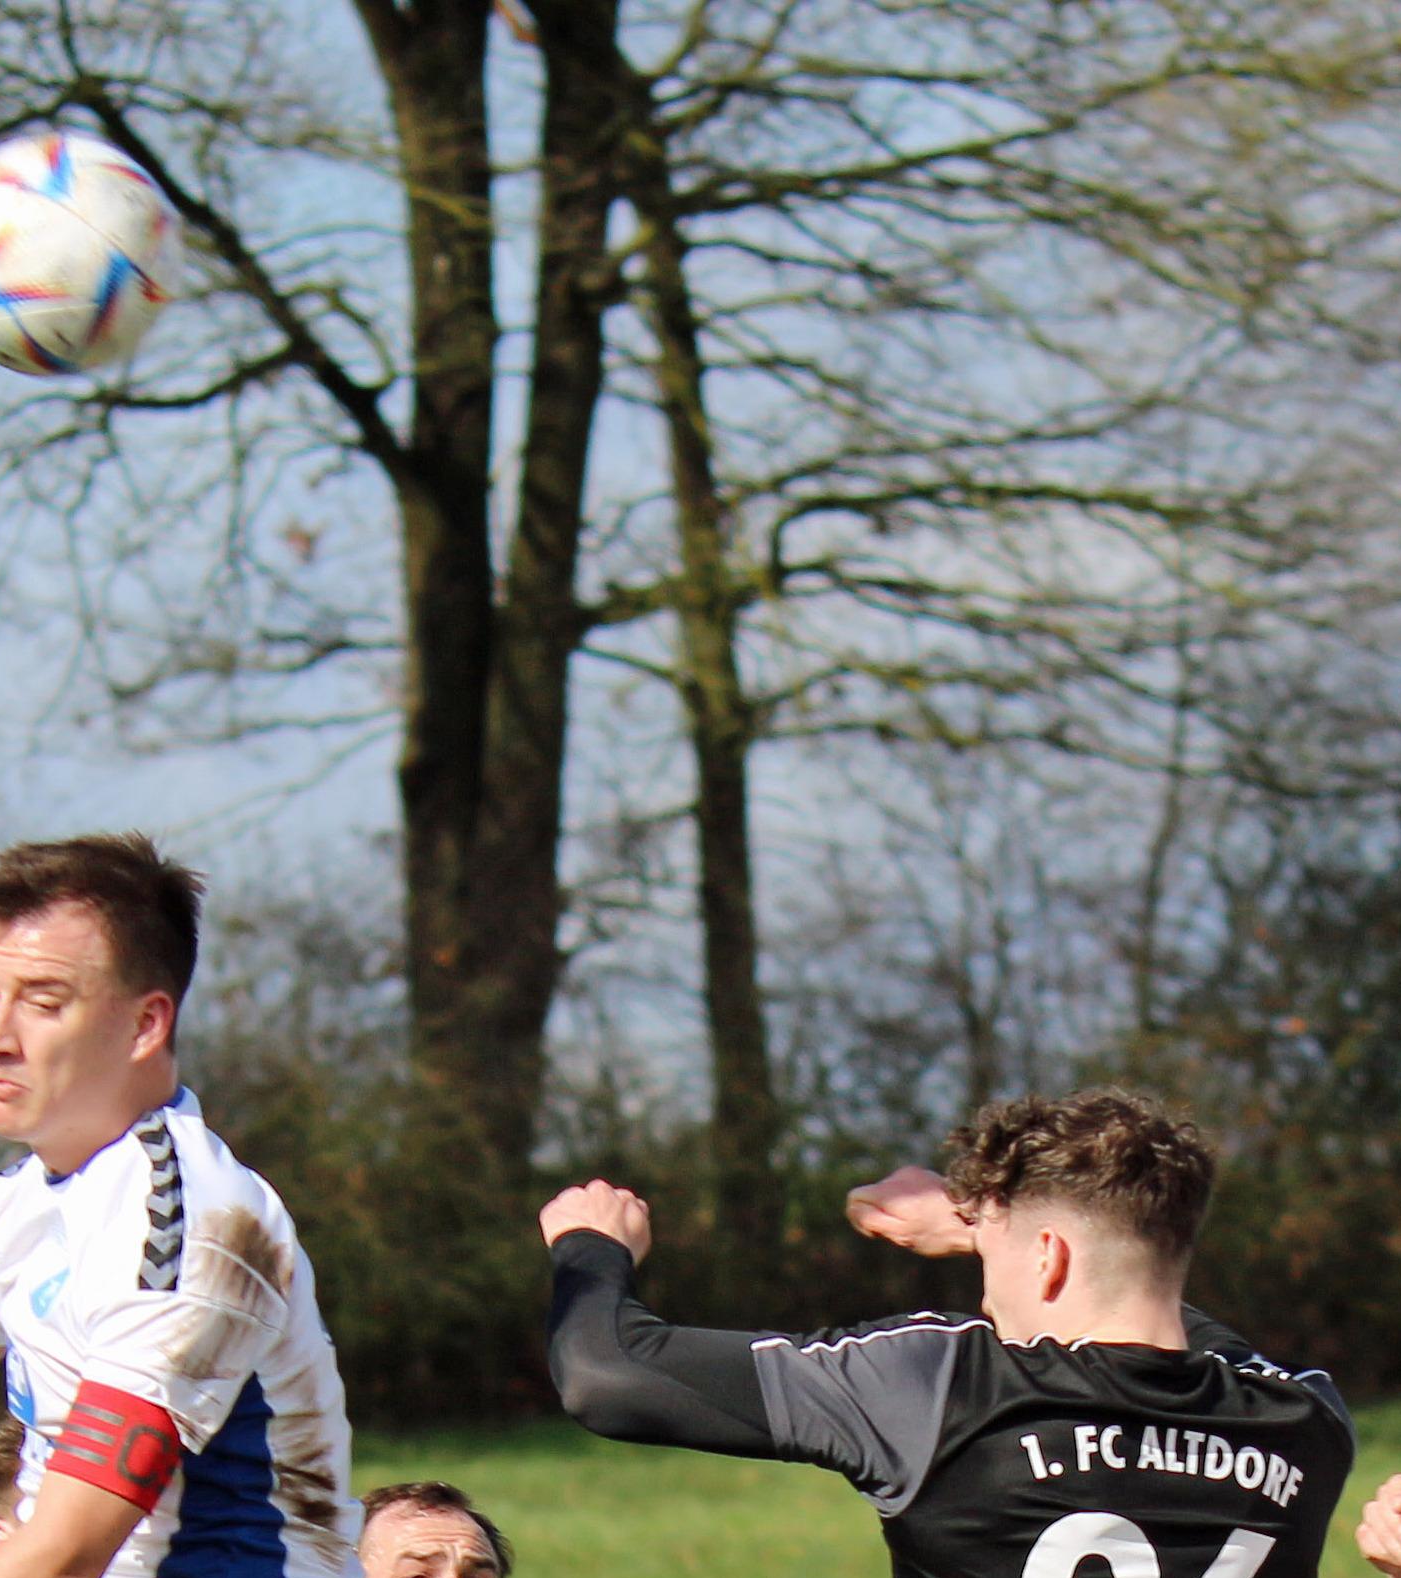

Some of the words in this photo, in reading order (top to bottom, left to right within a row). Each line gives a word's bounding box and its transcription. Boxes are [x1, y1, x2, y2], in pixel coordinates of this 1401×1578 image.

[1020, 1433, 1065, 1480] 1.
[1073, 1424, 1127, 1473] FC
[1136, 1424, 1304, 1508] ALTDORF
